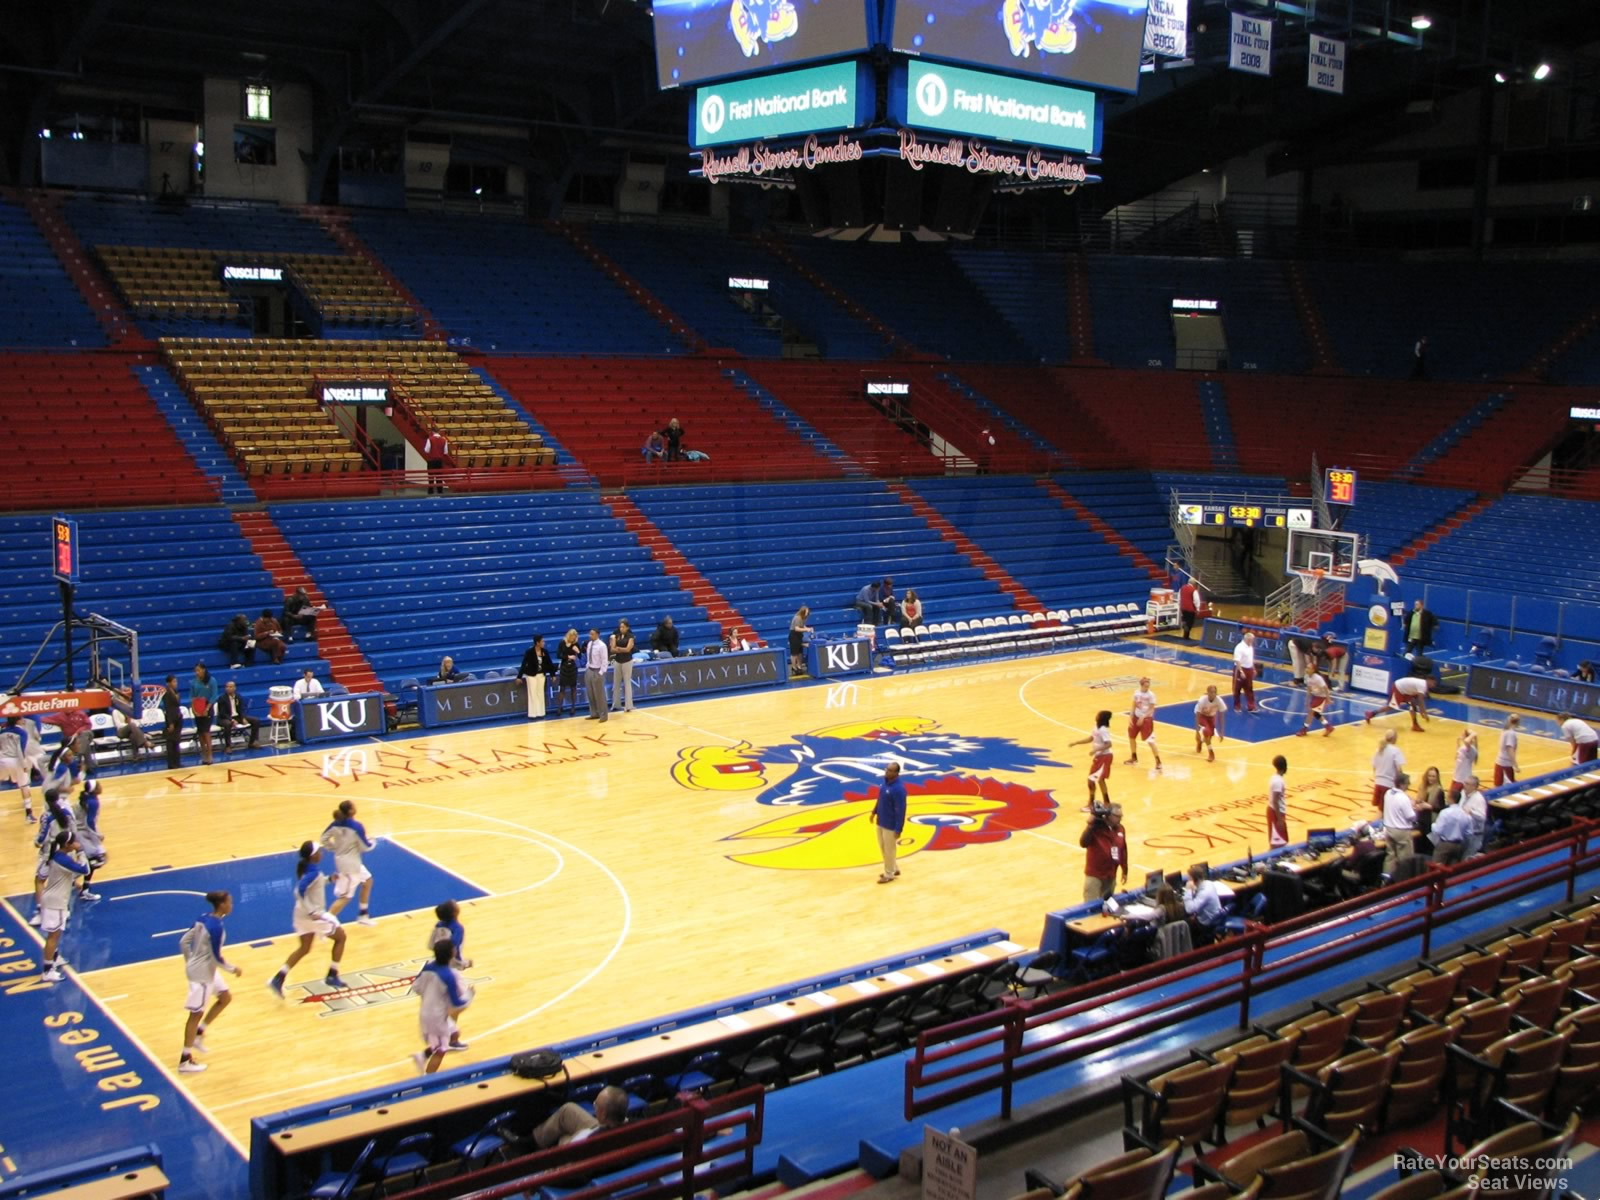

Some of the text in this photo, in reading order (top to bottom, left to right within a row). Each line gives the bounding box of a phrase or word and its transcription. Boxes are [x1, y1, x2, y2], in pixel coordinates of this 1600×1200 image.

[1233, 33, 1270, 51] FINAL FOUR
[1241, 20, 1262, 36] NCAA
[1241, 52, 1261, 69] 2008
[1311, 53, 1344, 71] FINAL FOUR
[1318, 41, 1336, 56] NCAA
[1317, 71, 1335, 87] 2012
[729, 85, 847, 121] First National Bank
[954, 89, 1087, 129] First National Bank
[701, 134, 862, 184] Russell Stover Candies
[898, 129, 1086, 181] Russell Stover Candies
[260, 267, 284, 281] MILK
[323, 388, 388, 401] MUSCLE MILK
[1331, 482, 1352, 501] 30
[825, 642, 859, 671] KU
[697, 660, 778, 685] JAYHA
[1489, 675, 1600, 706] THE PH
[317, 698, 367, 733] KU
[165, 742, 446, 789] KANSAS
[316, 728, 660, 789] JAYHAWKS
[381, 750, 613, 790] Allen Fieldhouse
[0, 926, 160, 1112] James Nais
[932, 1136, 968, 1164] NOT AN
